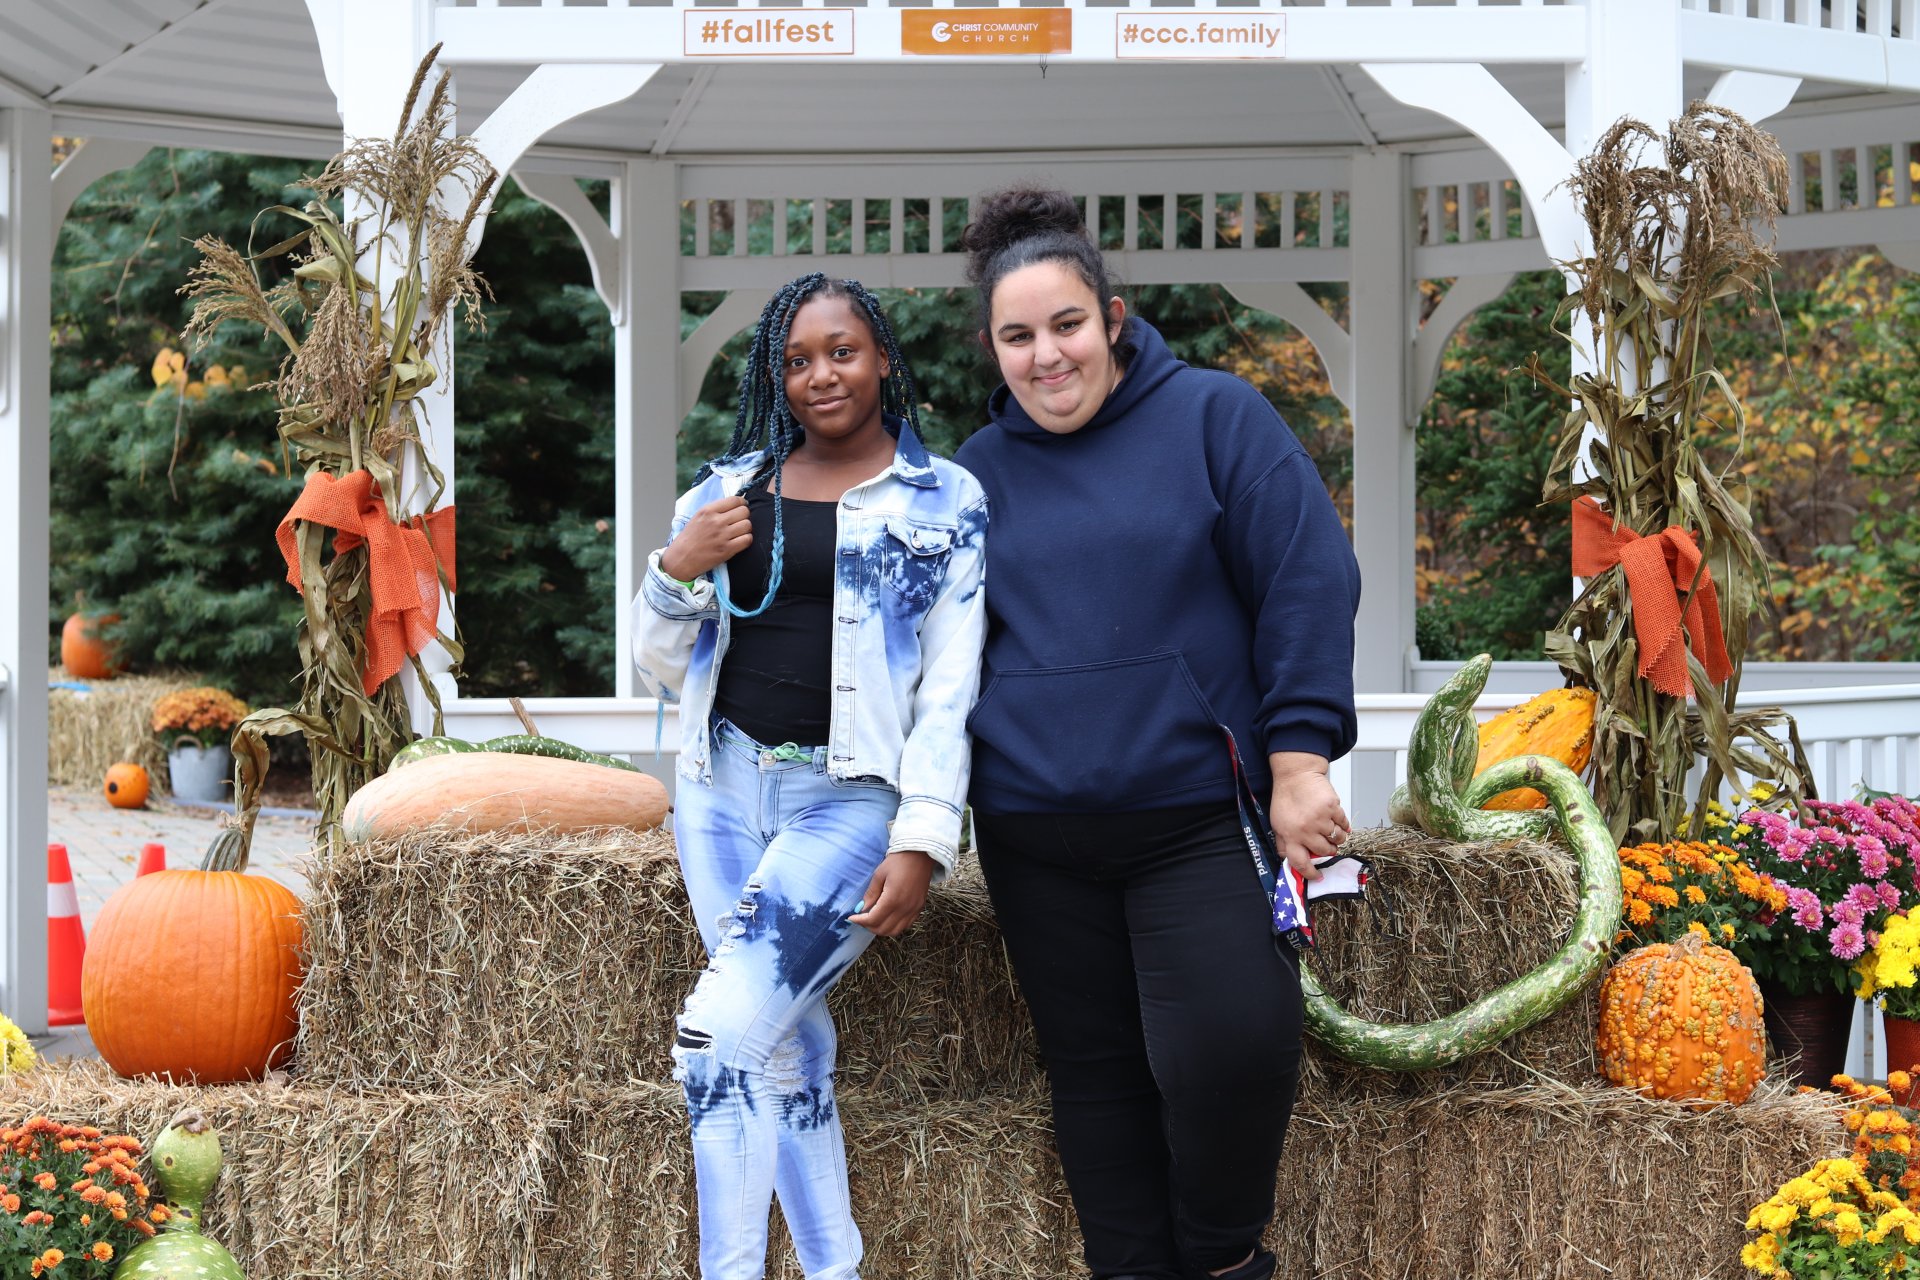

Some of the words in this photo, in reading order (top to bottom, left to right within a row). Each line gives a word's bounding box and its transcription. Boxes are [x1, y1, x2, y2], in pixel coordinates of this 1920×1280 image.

[701, 19, 834, 44] #fallfest
[952, 23, 982, 32] CHRIST
[983, 23, 1039, 32] COMMUNITY
[962, 34, 1029, 43] CHURCH
[1123, 22, 1281, 49] #ccc.family
[1243, 826, 1269, 876] PATRIOTS
